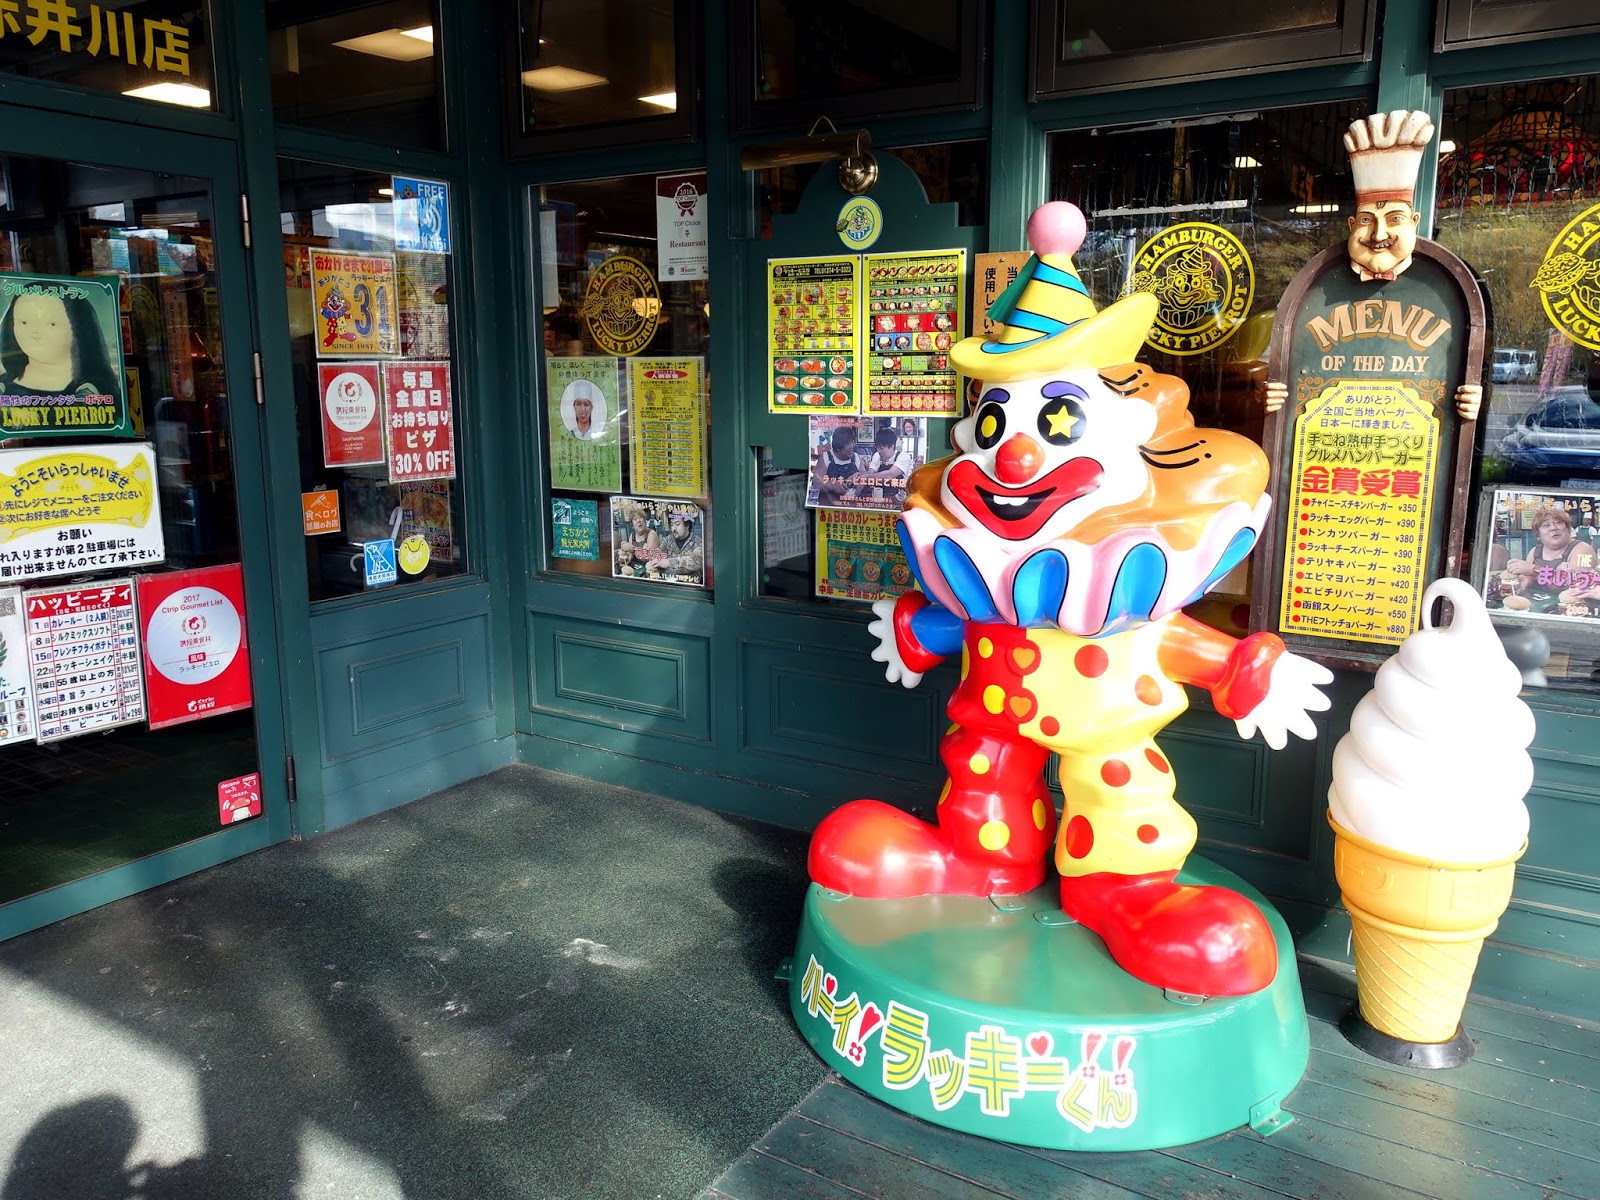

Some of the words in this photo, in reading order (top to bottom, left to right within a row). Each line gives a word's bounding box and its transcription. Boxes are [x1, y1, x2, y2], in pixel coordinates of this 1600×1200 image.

[417, 183, 445, 199] FREE
[670, 239, 706, 248] Restaurant
[1140, 229, 1243, 270] HAMBURGER
[592, 261, 652, 291] HAMBURGER
[3, 283, 90, 299] グルメレストラン
[1149, 326, 1185, 349] CKY
[1190, 284, 1247, 348] PIERROT
[592, 320, 624, 351] LUCKY
[626, 303, 657, 351] PIERROT
[1305, 299, 1452, 352] MENU
[1321, 355, 1346, 372] OF
[1353, 355, 1385, 372] THE
[1390, 355, 1430, 373] DAY
[402, 371, 433, 388] 毎週
[395, 390, 442, 408] 金曜日
[55, 405, 116, 425] PIERROT
[392, 410, 448, 427] お持ち帰り
[1323, 406, 1415, 417] 全国ご当地バーガー
[1320, 418, 1415, 430] 日本一に輝きました。
[406, 431, 436, 448] ピザ
[1306, 431, 1425, 450] 手こね熱中手づくり
[395, 453, 422, 474] 30%
[426, 451, 449, 470] OFF
[1306, 448, 1424, 467] グルメハンバーガー
[11, 462, 130, 498] ようこそいらっしゃいませ
[1301, 465, 1423, 499] 金賞受賞
[1311, 498, 1393, 511] チャイニーズチキンバーガー
[305, 509, 338, 521] 食べログ
[1309, 512, 1392, 526] ラッキーエッグバーガー
[57, 528, 93, 542] お願い
[1308, 528, 1390, 541] トンカツバーガー
[1306, 542, 1389, 556] ラッキーチーズバーガー
[1306, 557, 1387, 571] テリヤキバーガー
[1576, 553, 1593, 568] THE
[1304, 572, 1386, 586] エビマヨバーガー
[183, 594, 200, 603] 2017
[1303, 586, 1385, 601] エビチリバーガー
[162, 606, 179, 614] Ctrip
[181, 602, 209, 611] Gourmet
[1302, 600, 1383, 615] 函館スノーバーガー
[1301, 616, 1381, 631] THEフトッチョバーガー
